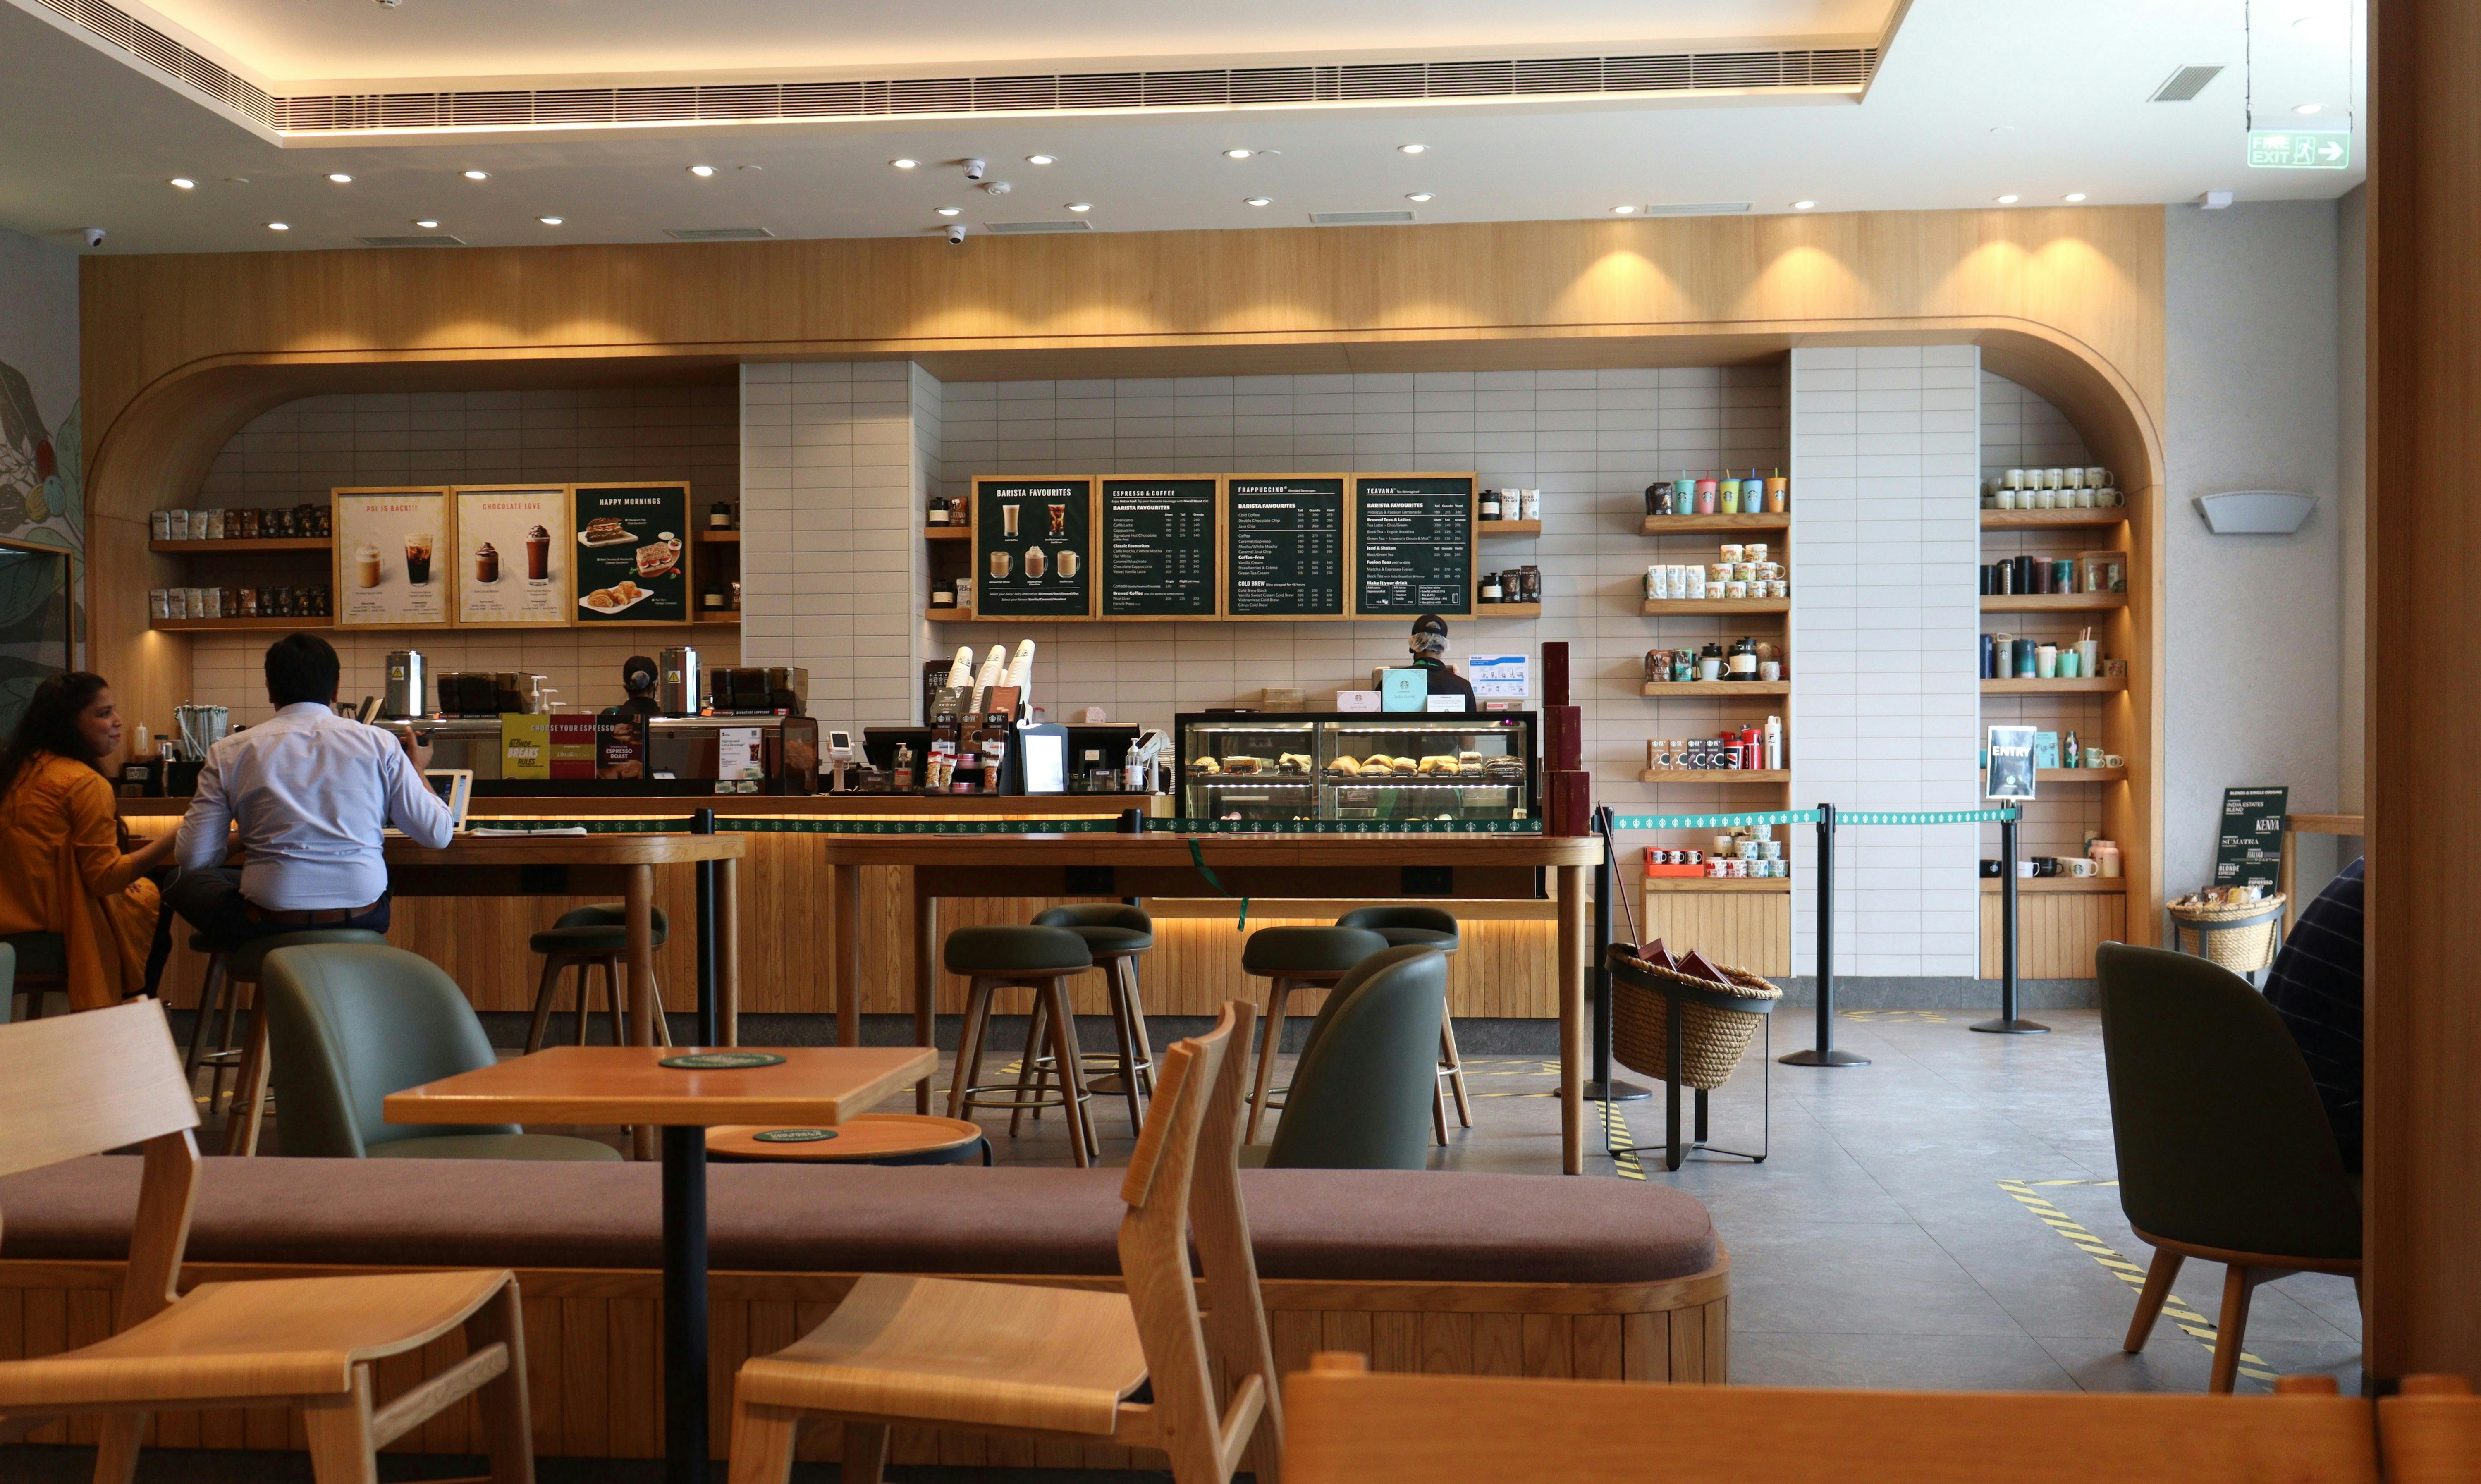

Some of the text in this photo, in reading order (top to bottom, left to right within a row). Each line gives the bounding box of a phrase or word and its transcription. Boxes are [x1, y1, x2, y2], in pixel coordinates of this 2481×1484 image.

[2253, 151, 2290, 163] EXIT
[507, 748, 539, 758] BREAKS
[1993, 746, 2031, 756] ENTRY
[2256, 820, 2279, 830] KENYA
